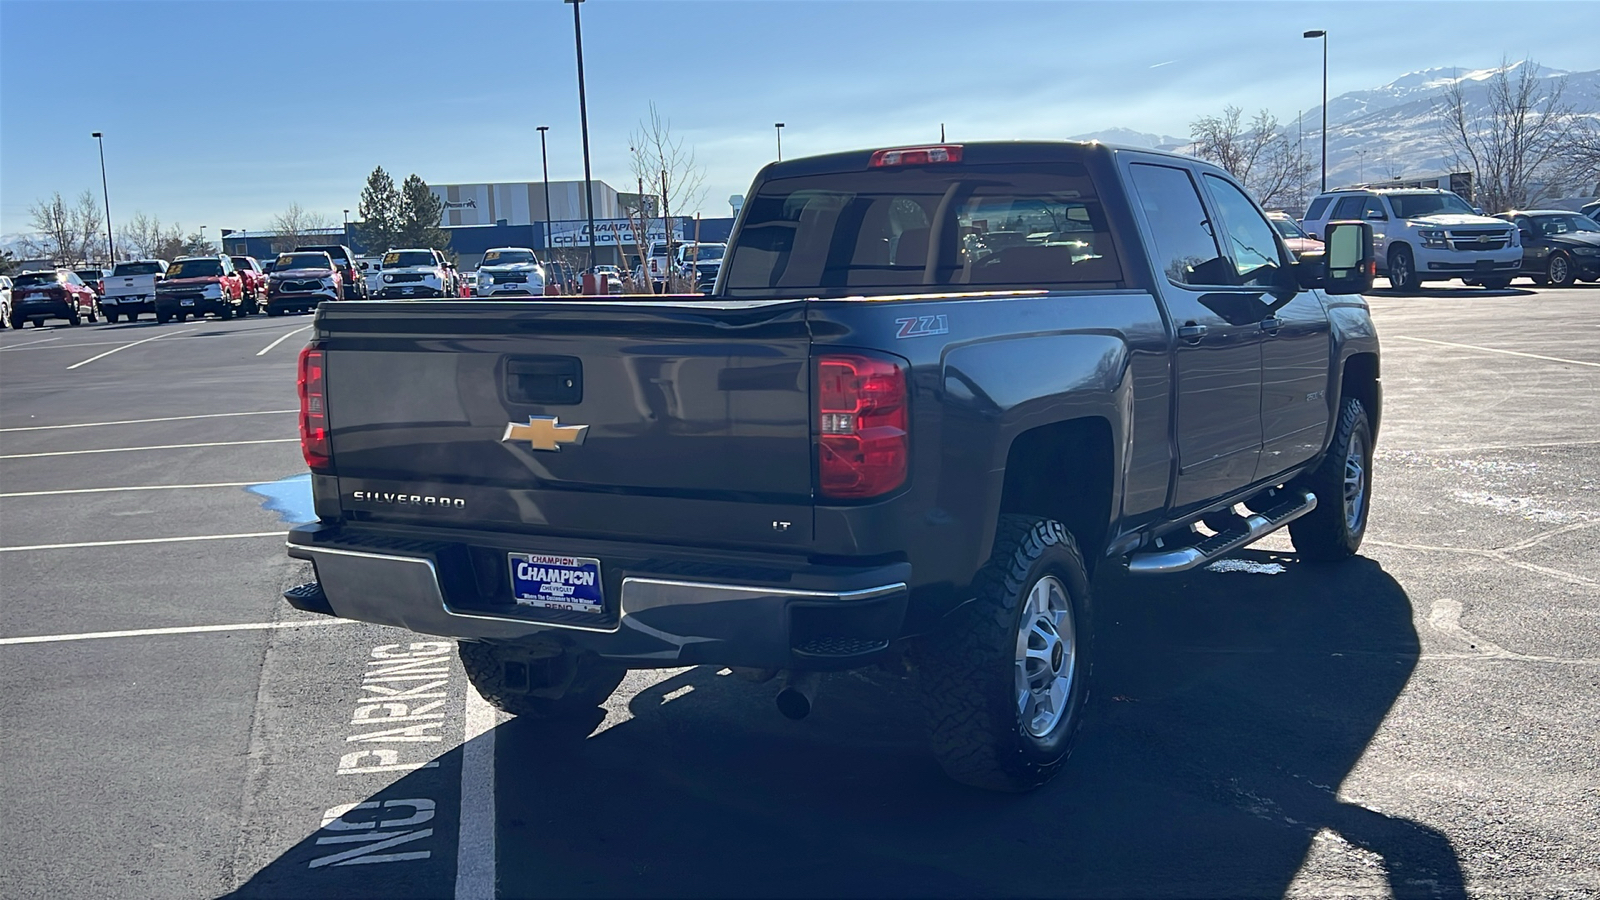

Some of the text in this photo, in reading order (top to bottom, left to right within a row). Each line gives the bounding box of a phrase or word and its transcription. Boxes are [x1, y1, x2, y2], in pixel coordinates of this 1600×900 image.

[581, 223, 645, 235] CHAMPIO
[623, 232, 675, 241] CETE
[895, 314, 949, 339] Z71
[353, 491, 465, 509] SILVERADO
[772, 521, 791, 532] LT
[532, 556, 575, 566] CHAMPION
[517, 562, 595, 586] CHAMPION
[541, 585, 573, 593] CHEVROLET
[308, 641, 457, 869] NO PARKING
